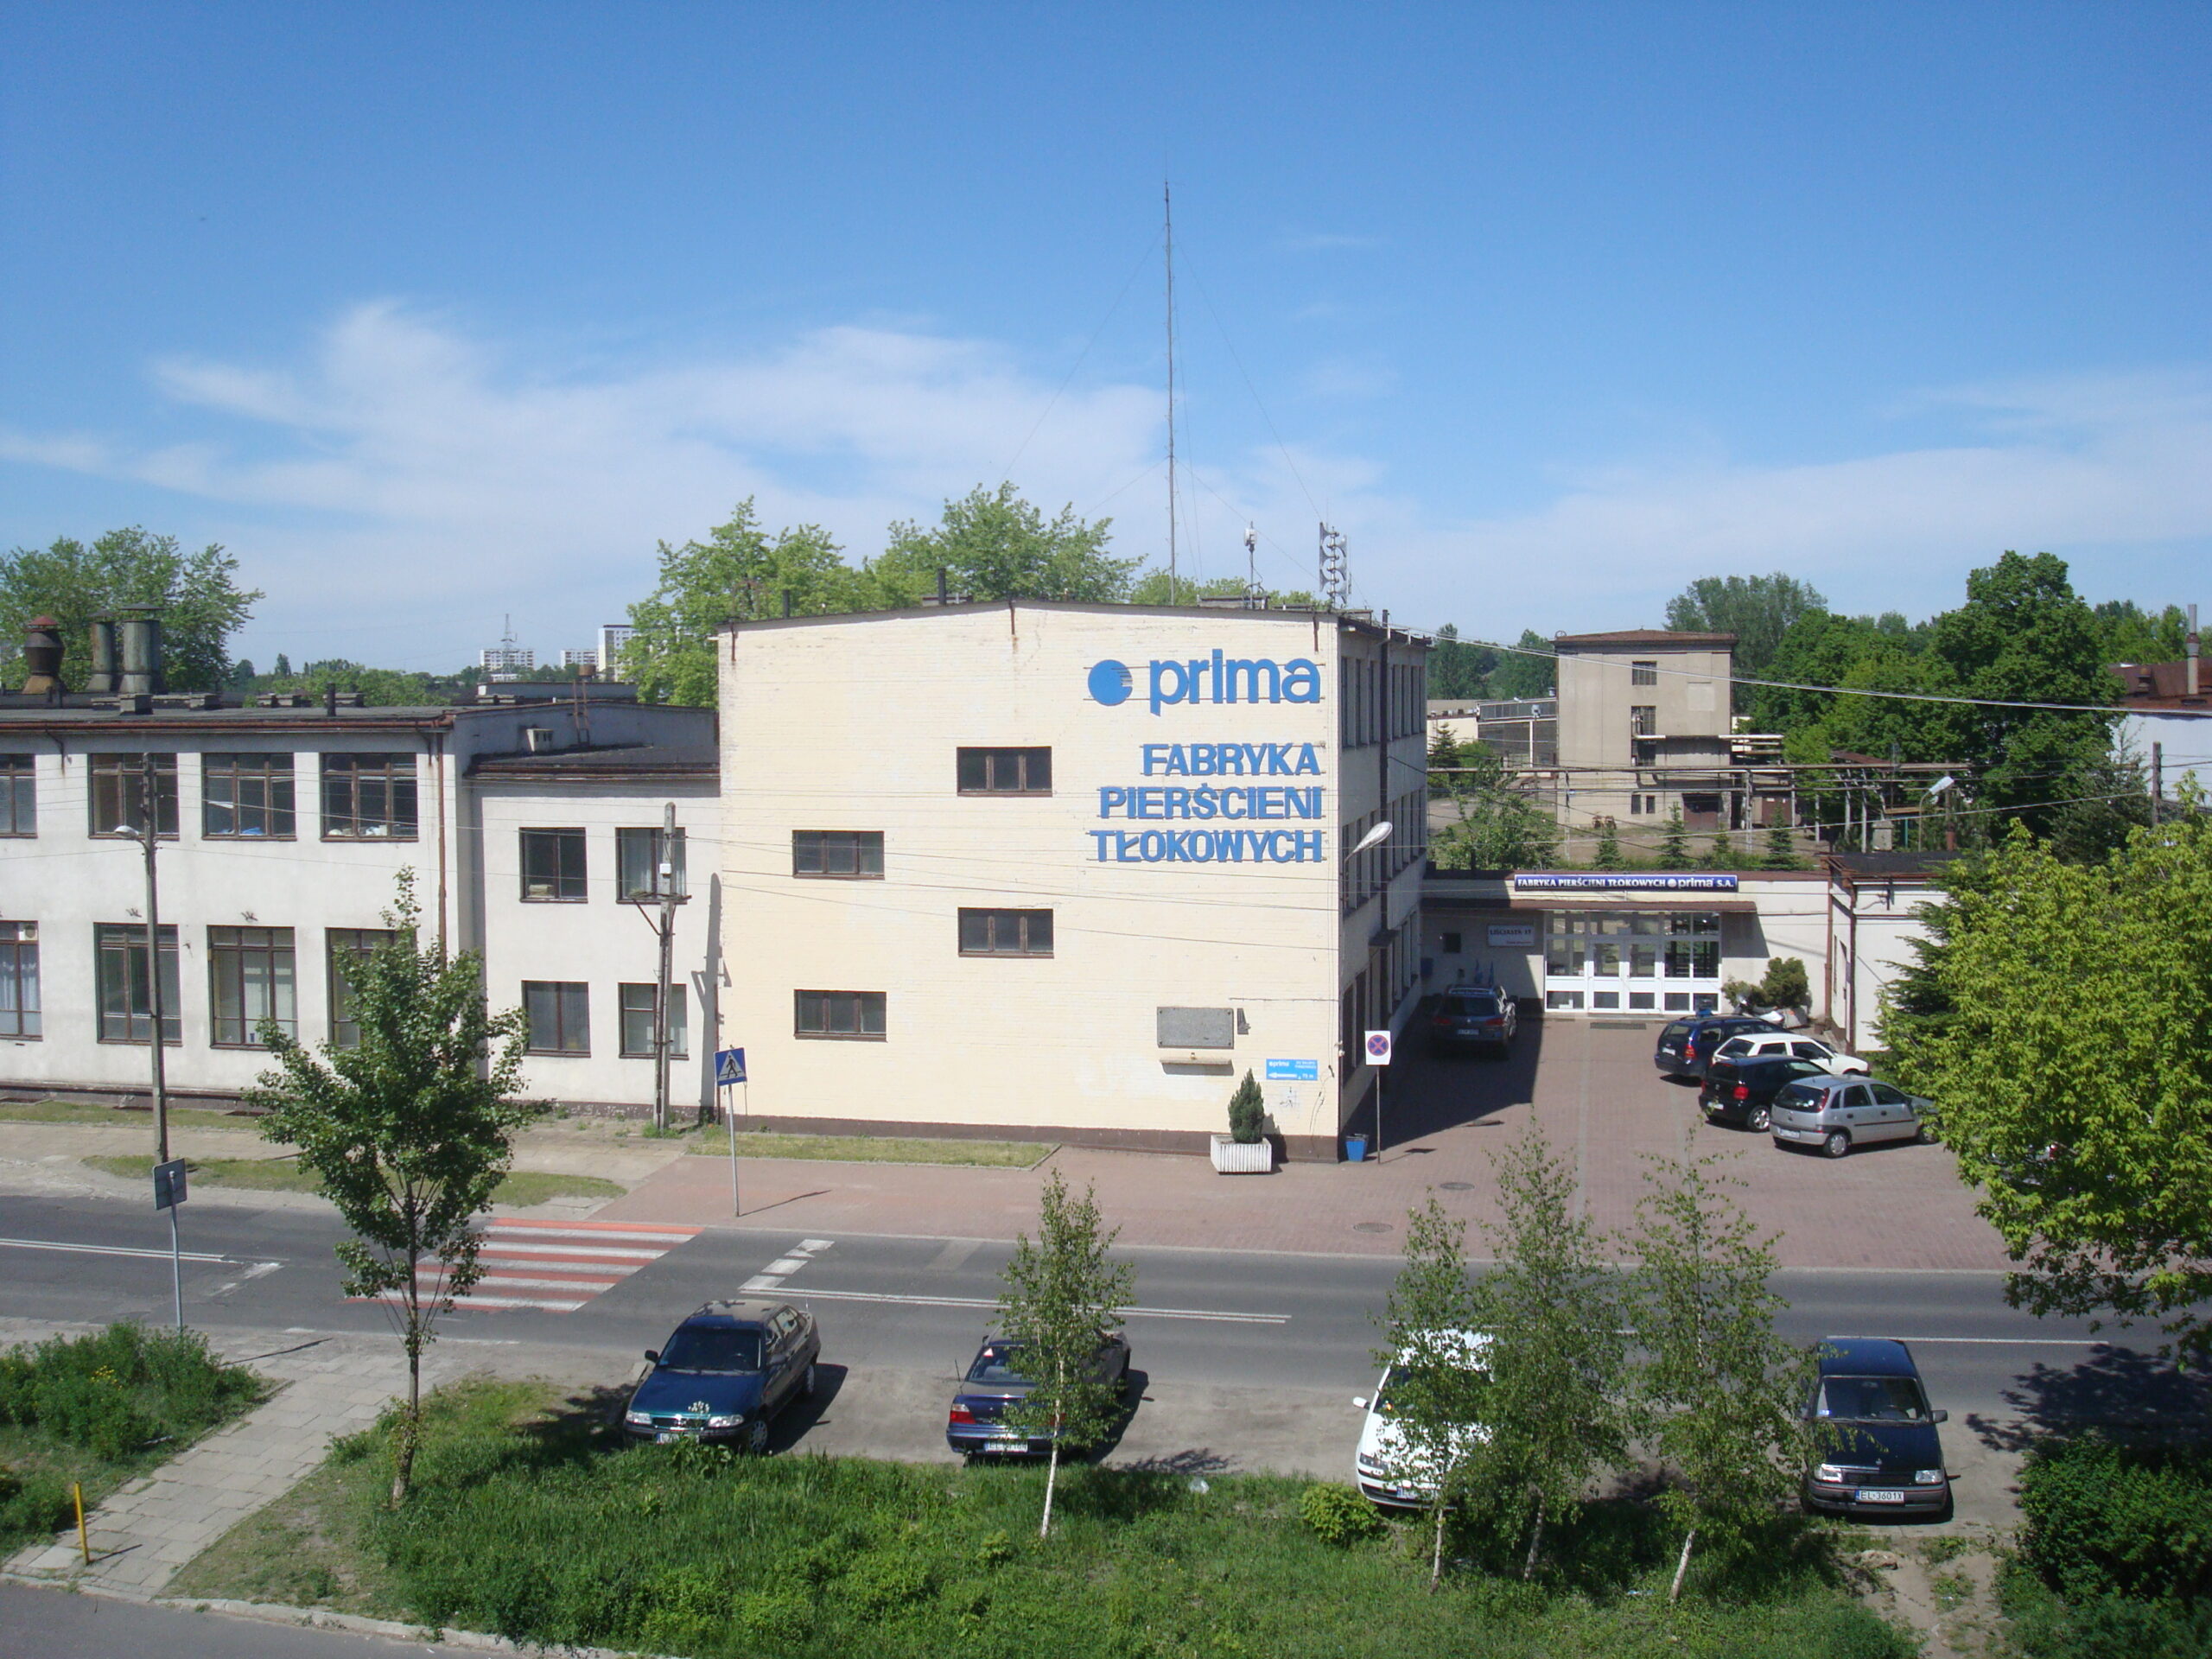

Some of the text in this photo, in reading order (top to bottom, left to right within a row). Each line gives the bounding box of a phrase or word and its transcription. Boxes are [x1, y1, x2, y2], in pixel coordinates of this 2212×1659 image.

[1149, 648, 1321, 716] prima
[1142, 742, 1321, 776] FABRYKA
[1099, 782, 1322, 820] PIERŚCIENI
[1089, 830, 1322, 863] TŁOKOWYCH
[1517, 876, 1734, 889] FABRYKA PIERŚCIENI TŁOKOWYCH prima S.A.
